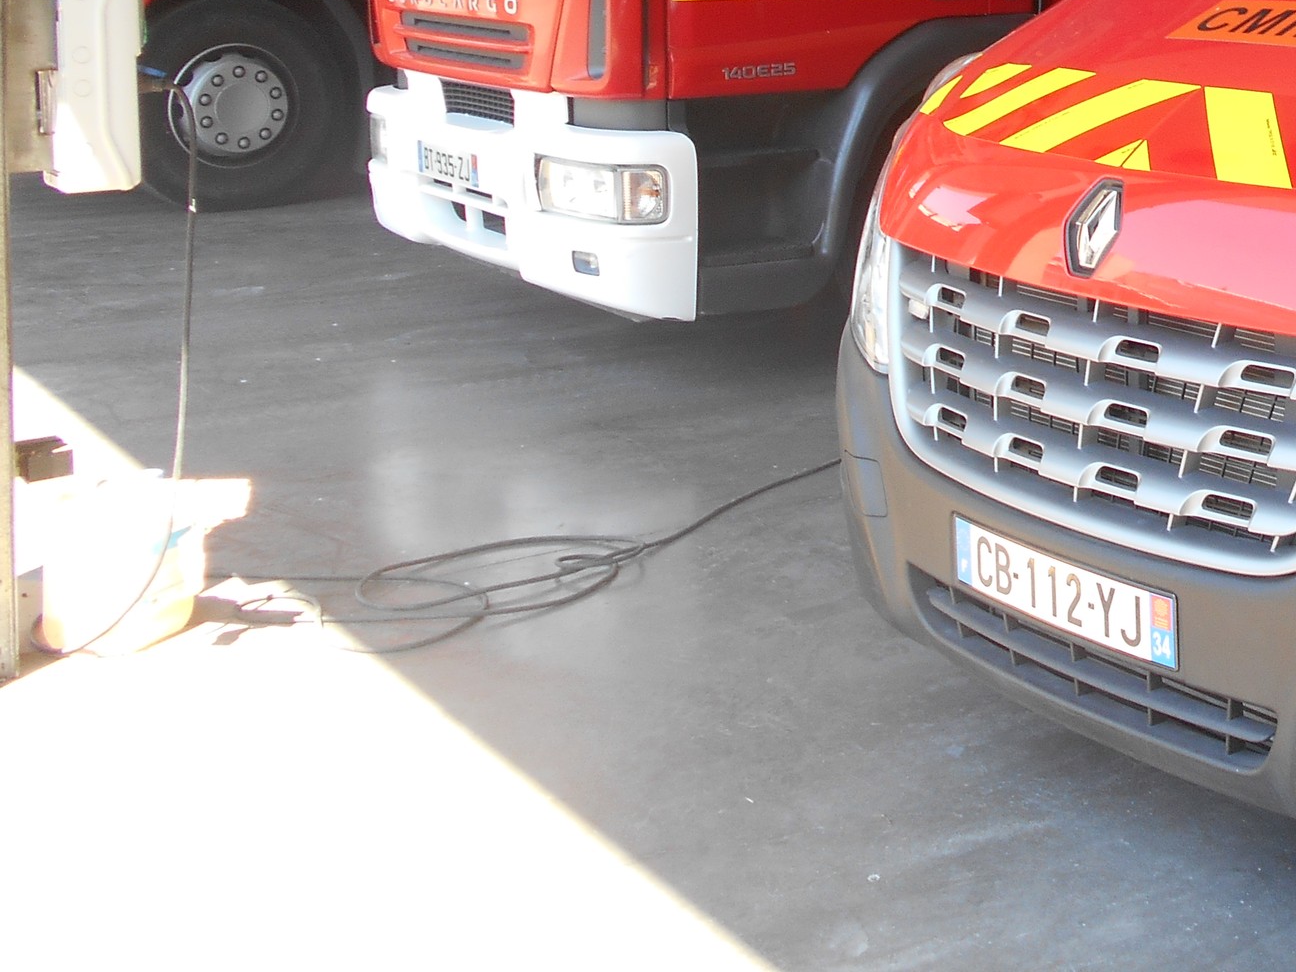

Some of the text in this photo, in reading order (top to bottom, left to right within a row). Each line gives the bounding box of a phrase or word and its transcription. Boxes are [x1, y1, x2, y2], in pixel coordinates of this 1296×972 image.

[721, 62, 797, 80] 140E25
[423, 147, 470, 181] BT-935-ZJ
[976, 535, 1142, 647] CB-112-YJ
[1152, 631, 1171, 659] 34
